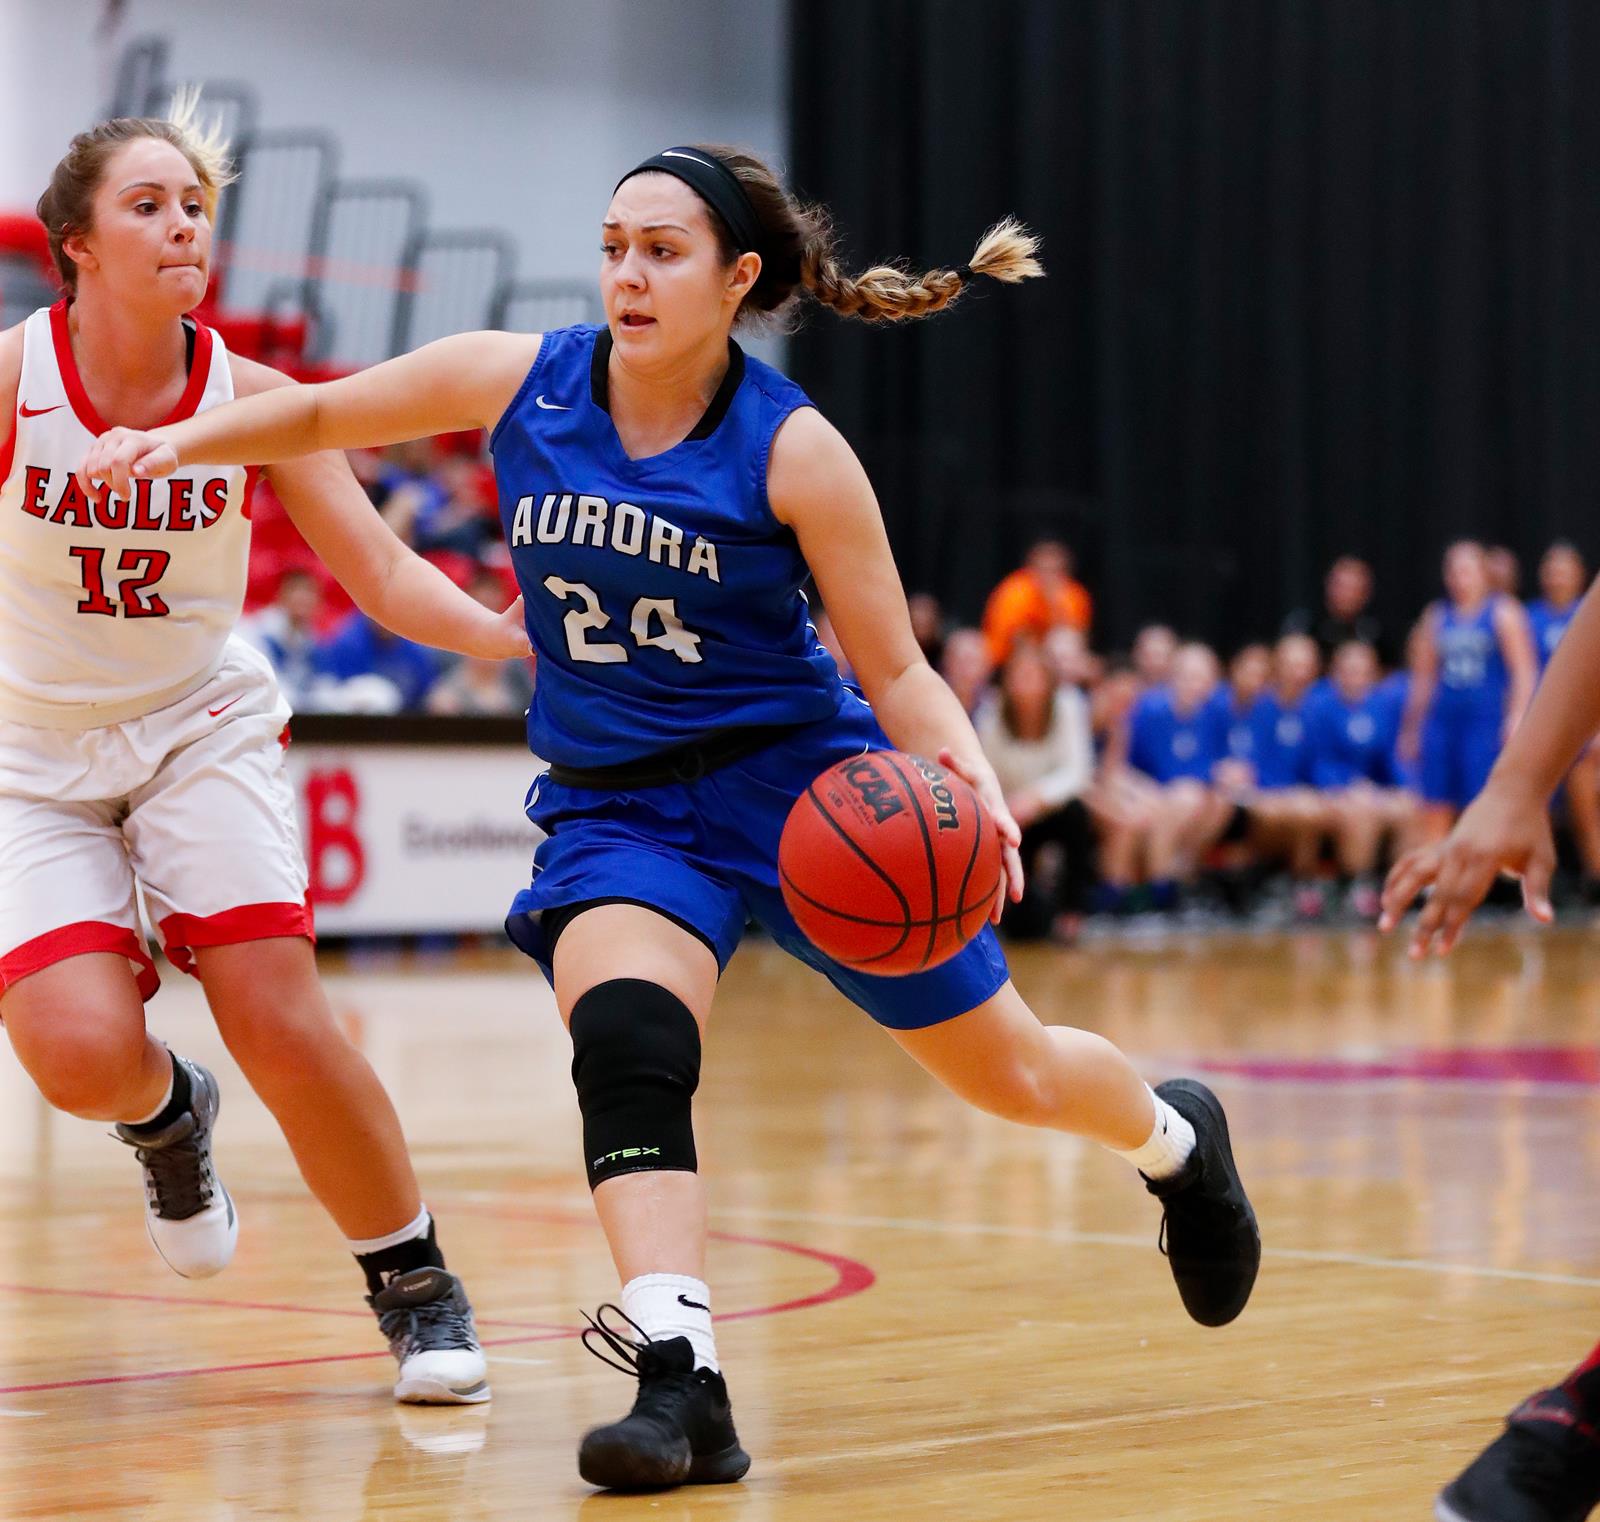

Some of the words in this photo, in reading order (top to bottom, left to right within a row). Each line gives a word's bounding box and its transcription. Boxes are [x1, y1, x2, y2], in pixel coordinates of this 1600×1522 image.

[21, 466, 228, 531] EAGLES
[511, 494, 720, 583] AURORA
[69, 546, 170, 618] 12
[543, 575, 703, 664] 24
[908, 757, 960, 832] son
